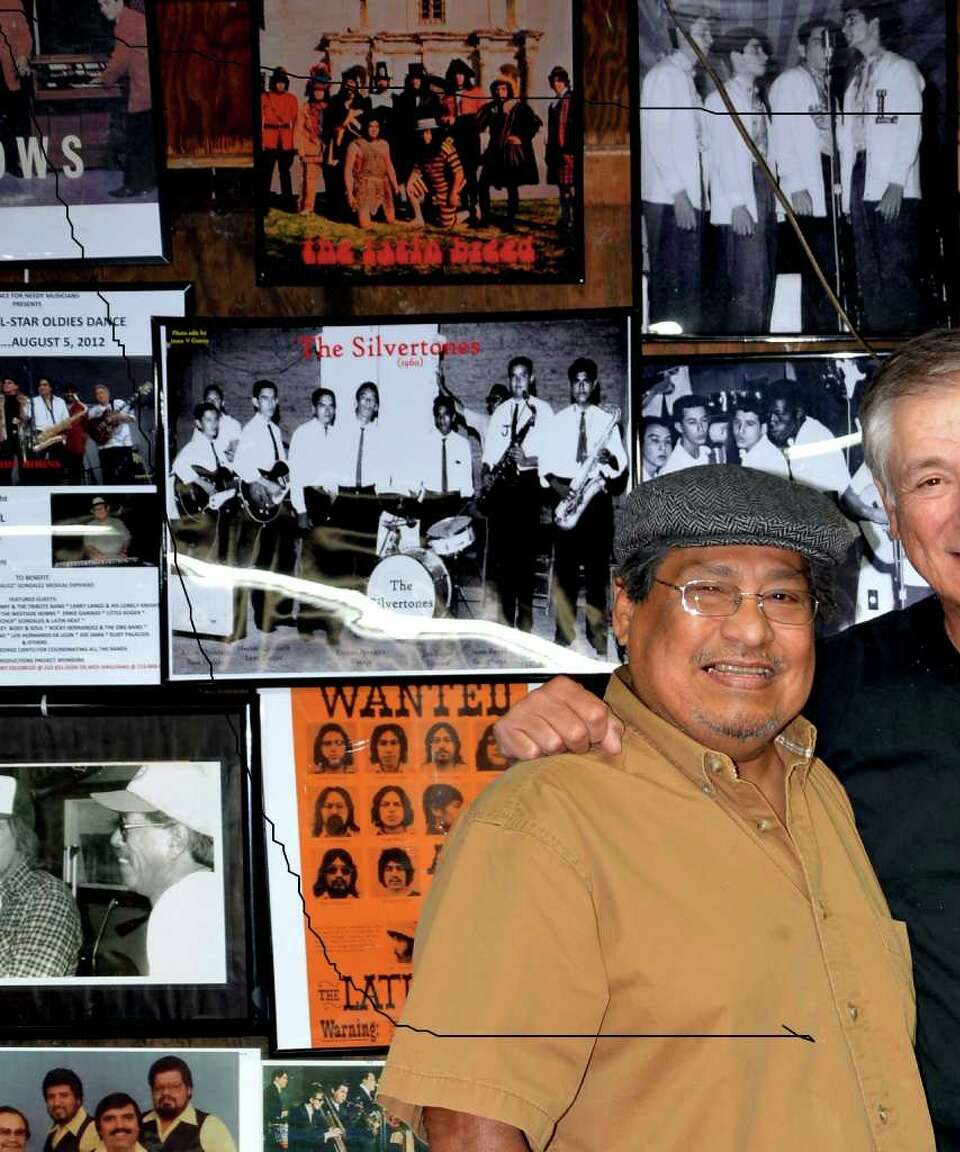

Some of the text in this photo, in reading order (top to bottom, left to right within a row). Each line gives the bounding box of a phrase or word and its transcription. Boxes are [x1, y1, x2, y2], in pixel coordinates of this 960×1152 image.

[42, 316, 83, 327] OLDIES
[87, 316, 127, 327] DANCE
[64, 337, 74, 348] 5,
[78, 337, 105, 347] 2012
[298, 334, 480, 359] The Silvertones
[389, 579, 413, 591] The
[320, 682, 512, 718] WANTED
[318, 989, 340, 1001] THE
[320, 1019, 379, 1042] Warning:
